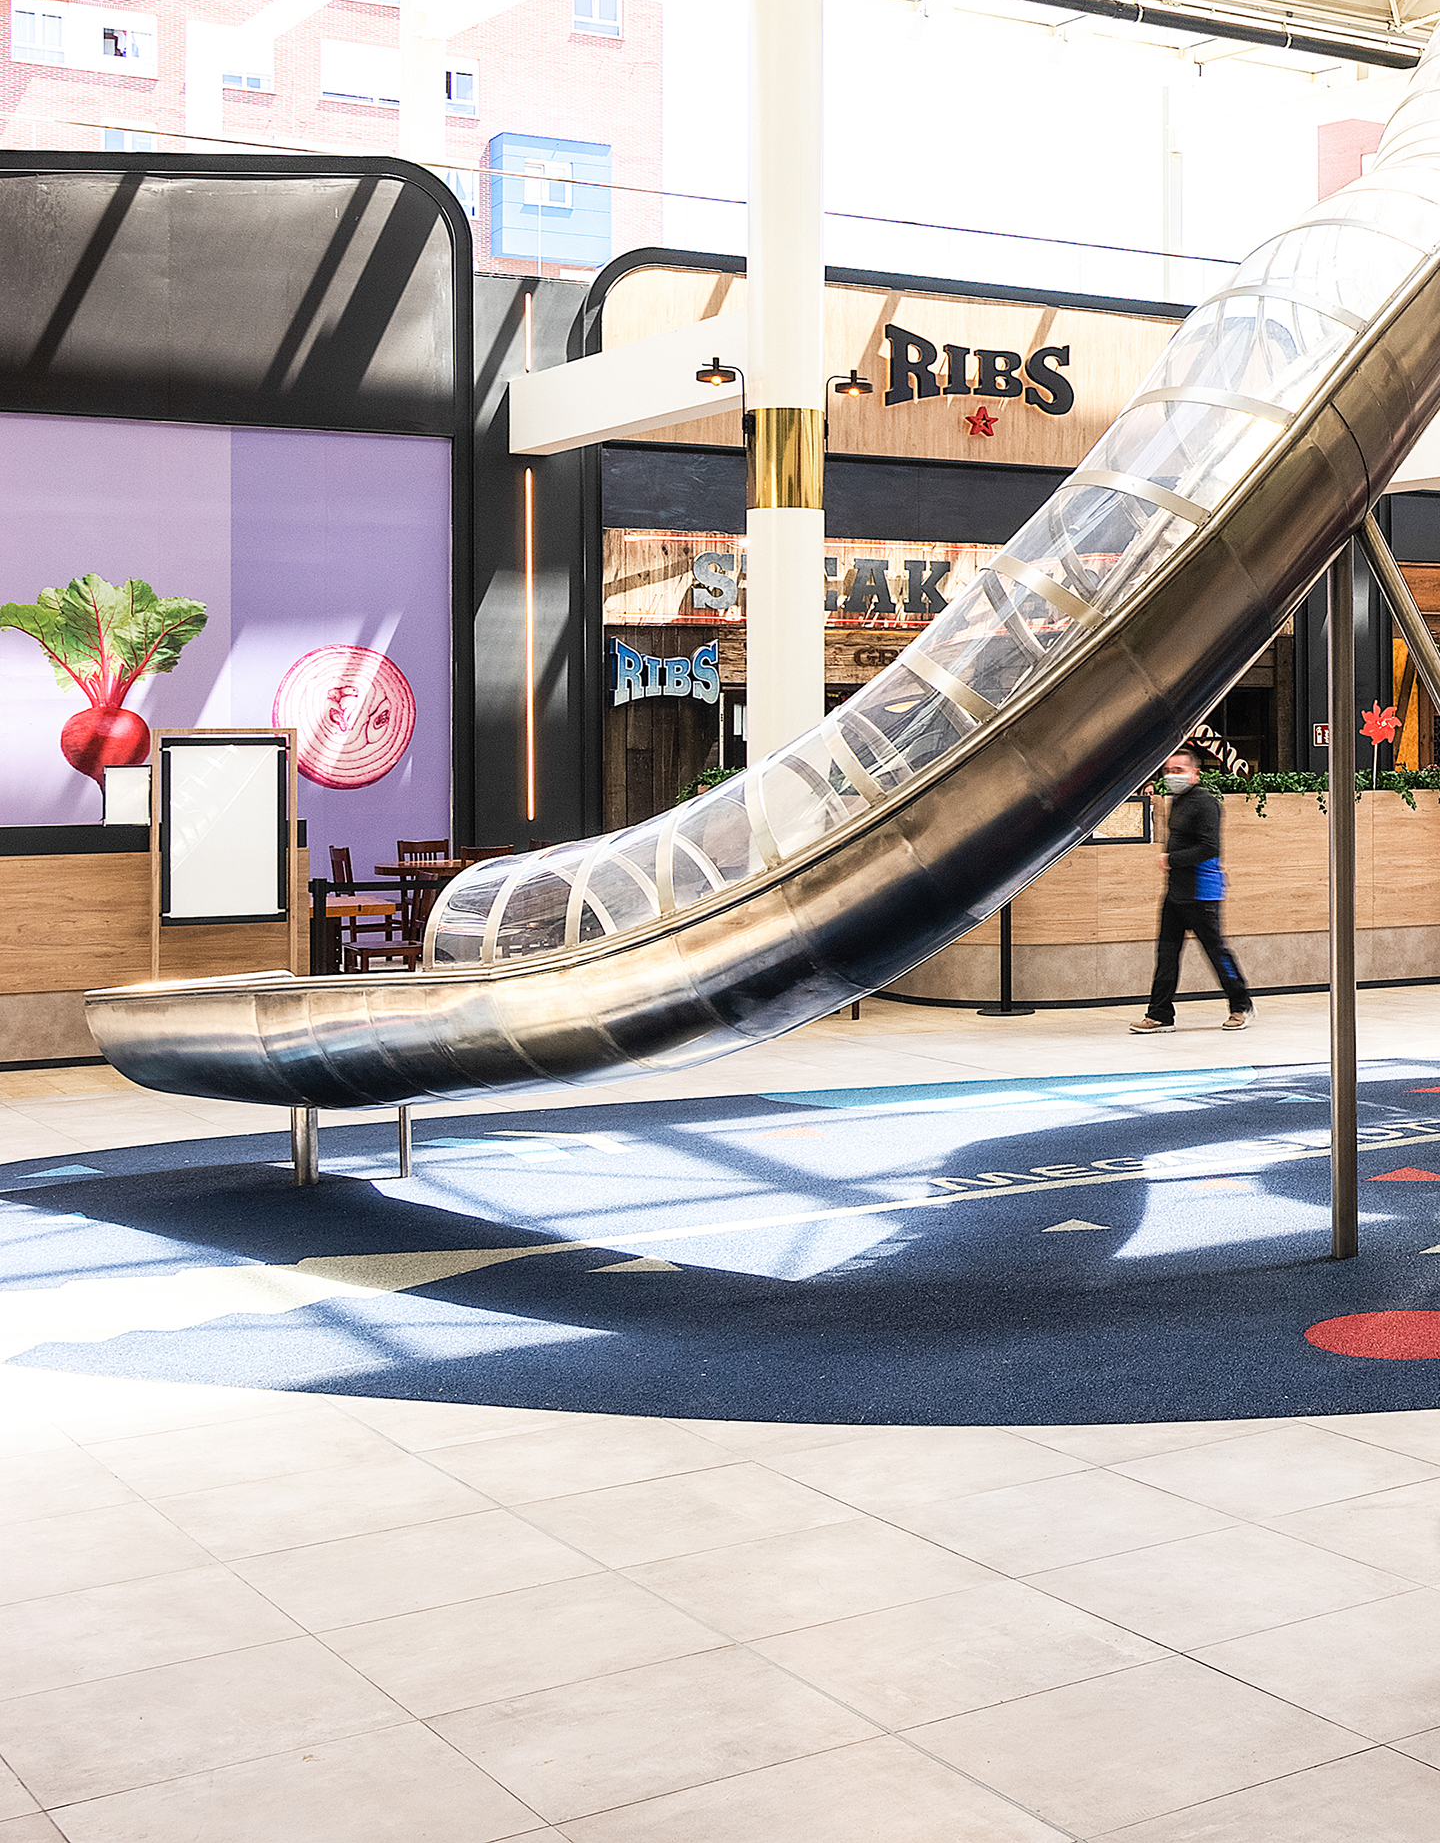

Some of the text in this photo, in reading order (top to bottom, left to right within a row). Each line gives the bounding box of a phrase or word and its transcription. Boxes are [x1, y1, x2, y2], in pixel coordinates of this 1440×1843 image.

[885, 323, 1075, 416] RIBS
[692, 551, 953, 614] SAK
[610, 636, 720, 706] RIBS
[928, 1151, 1224, 1192] MEGA
